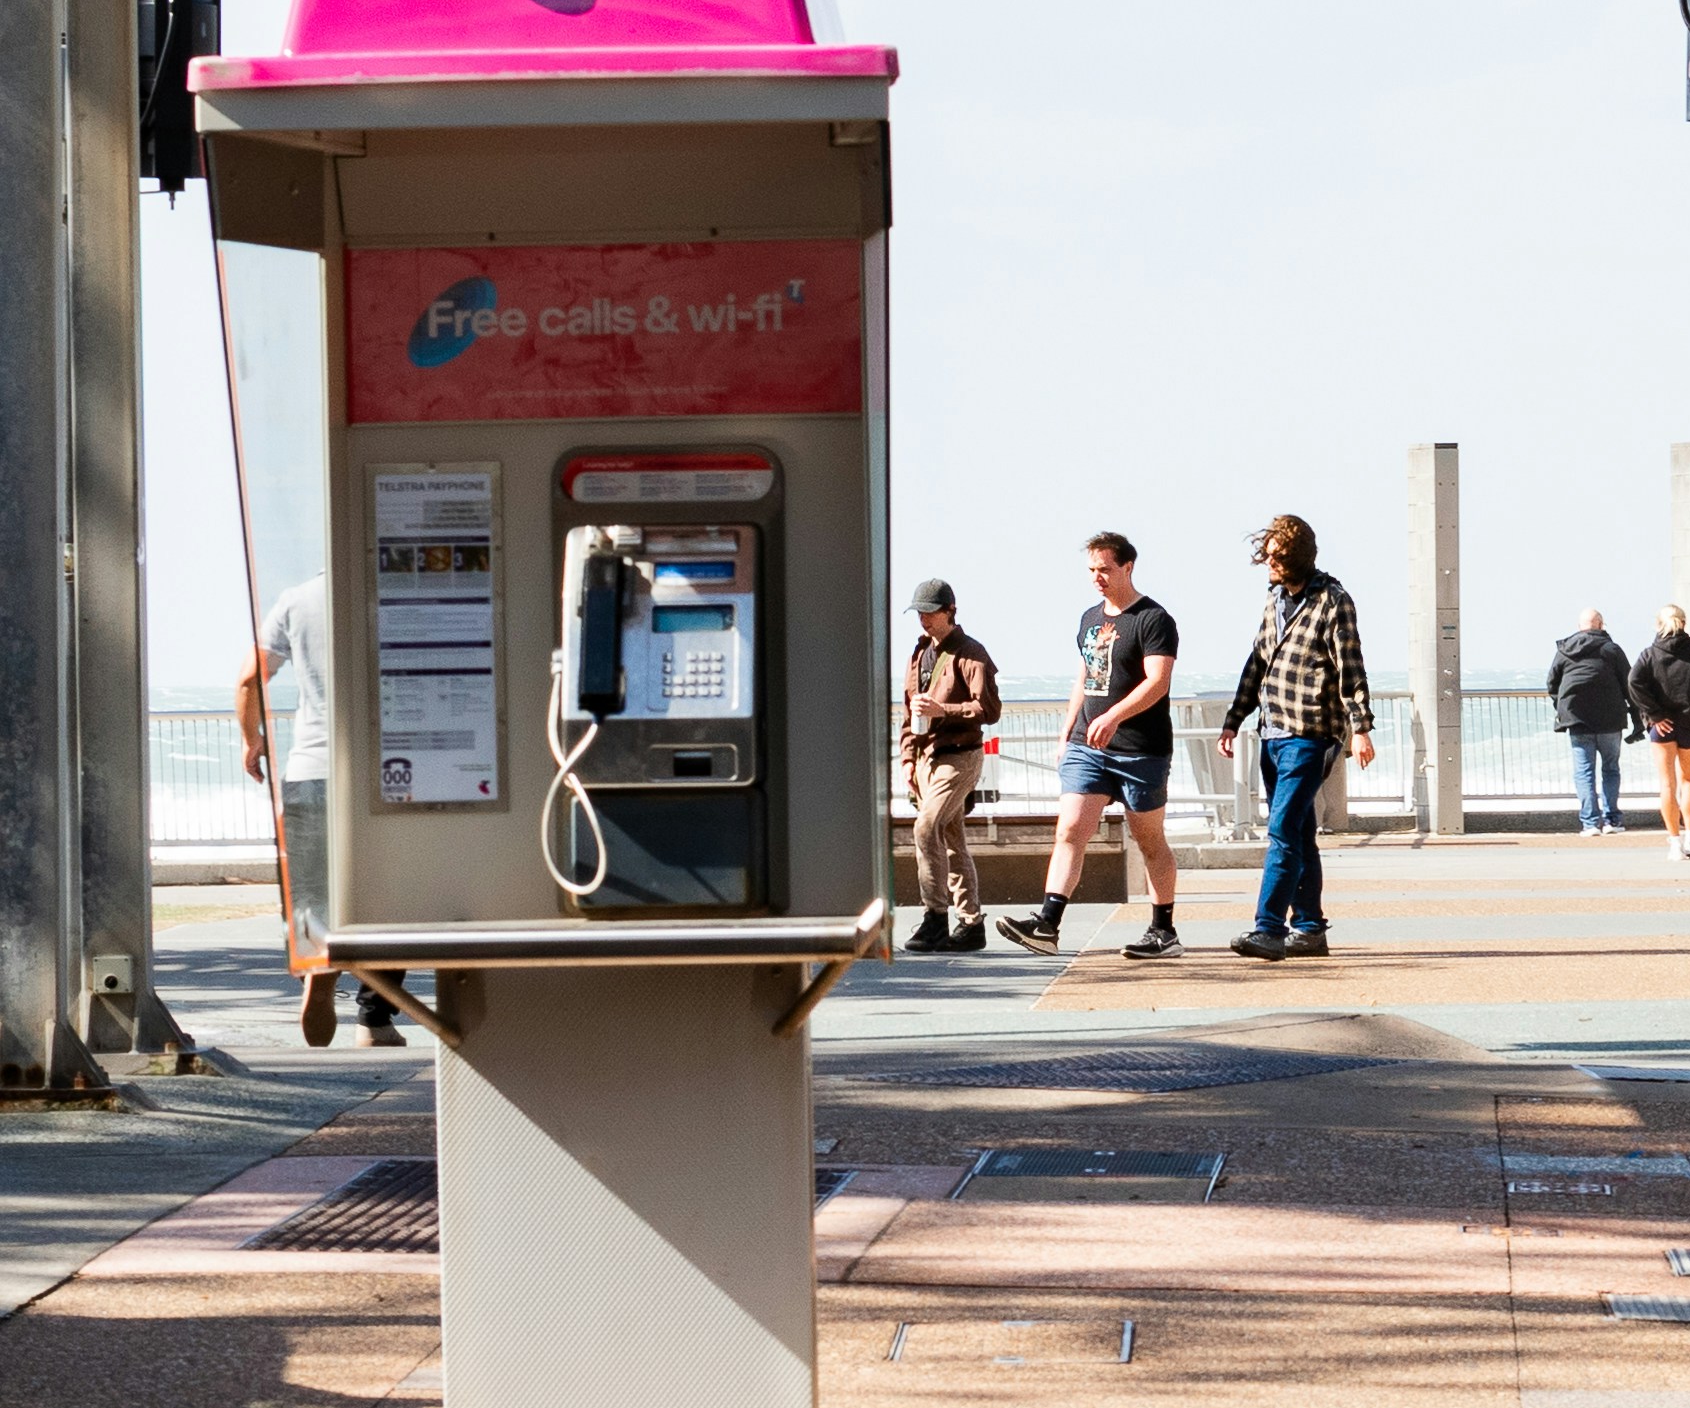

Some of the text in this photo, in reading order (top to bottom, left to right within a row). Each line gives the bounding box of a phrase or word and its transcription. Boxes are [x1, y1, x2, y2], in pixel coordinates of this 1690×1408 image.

[789, 279, 806, 299] T
[427, 293, 783, 338] Free calls & wi-fi
[378, 481, 425, 492] TELSTRA
[380, 553, 463, 567] 1 2 3
[383, 769, 412, 785] 000
